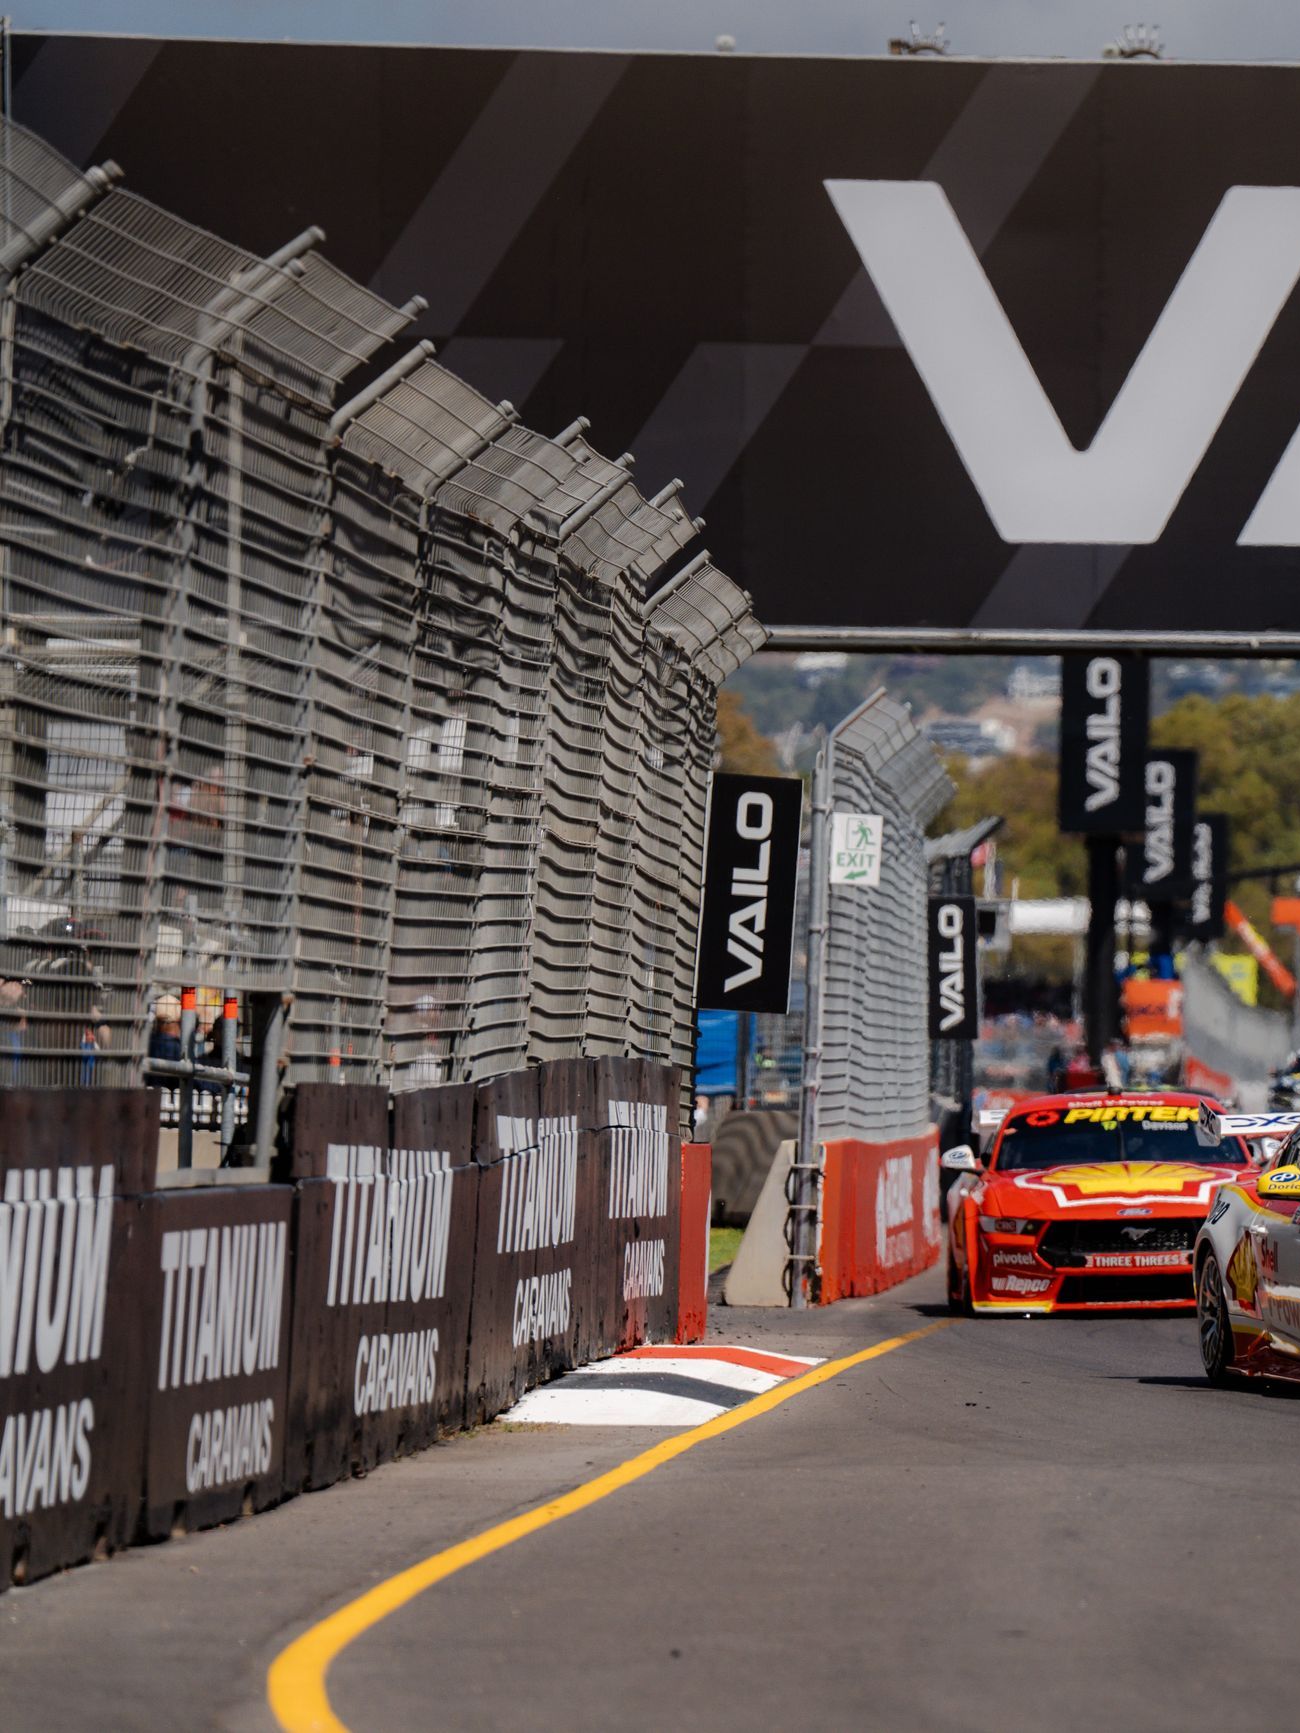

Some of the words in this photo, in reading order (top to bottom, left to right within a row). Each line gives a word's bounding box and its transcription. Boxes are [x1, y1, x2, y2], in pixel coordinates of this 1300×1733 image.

[1085, 657, 1121, 812] VAILO
[837, 852, 876, 868] EXIT
[1142, 761, 1176, 884] VAILO
[724, 791, 773, 993] VAILO
[938, 904, 965, 1032] VAILO
[608, 1099, 669, 1220] TITANIUM
[1064, 1106, 1199, 1124] PIRTEK
[327, 1142, 454, 1307] TITANIUM
[496, 1114, 579, 1255] TITANIUM
[158, 1220, 287, 1391] TITANIUM
[512, 1267, 572, 1348] CARAVANS
[623, 1238, 666, 1302] CARAVANS
[1005, 1274, 1050, 1294] Repco
[1095, 1255, 1132, 1267] THREE
[1135, 1254, 1179, 1267] THREES
[353, 1327, 439, 1417] CARAVANS
[186, 1398, 274, 1494] CARAVANS
